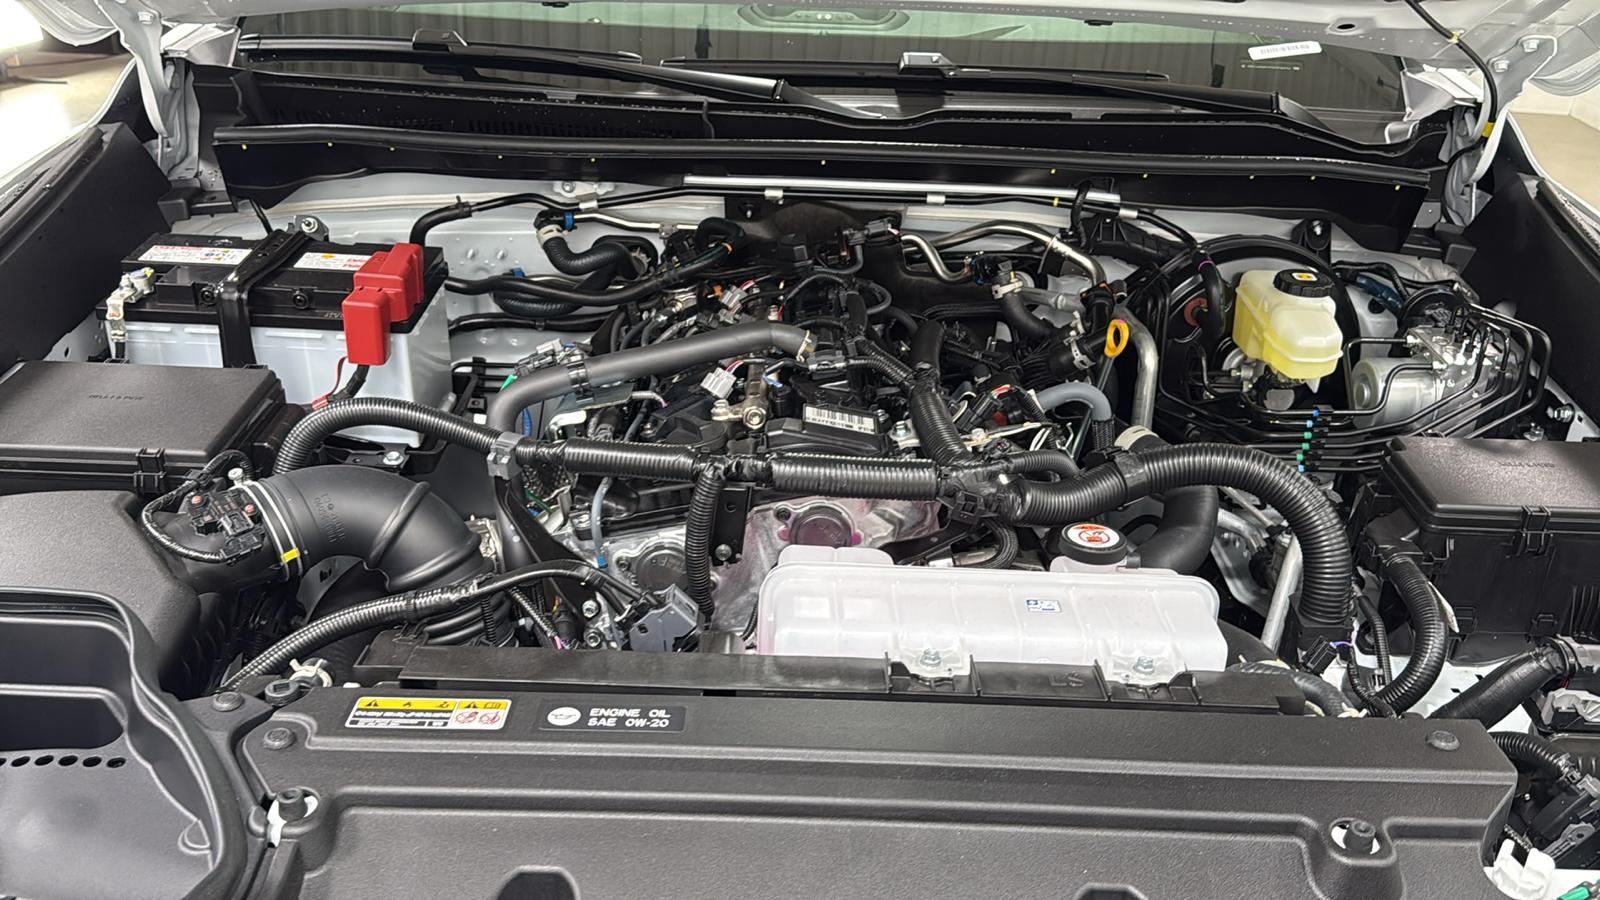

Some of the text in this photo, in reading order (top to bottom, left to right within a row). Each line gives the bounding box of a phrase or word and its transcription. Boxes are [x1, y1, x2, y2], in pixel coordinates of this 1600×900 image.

[589, 707, 672, 718] ENGINE OIL
[587, 717, 670, 728] SAE 0W-20
